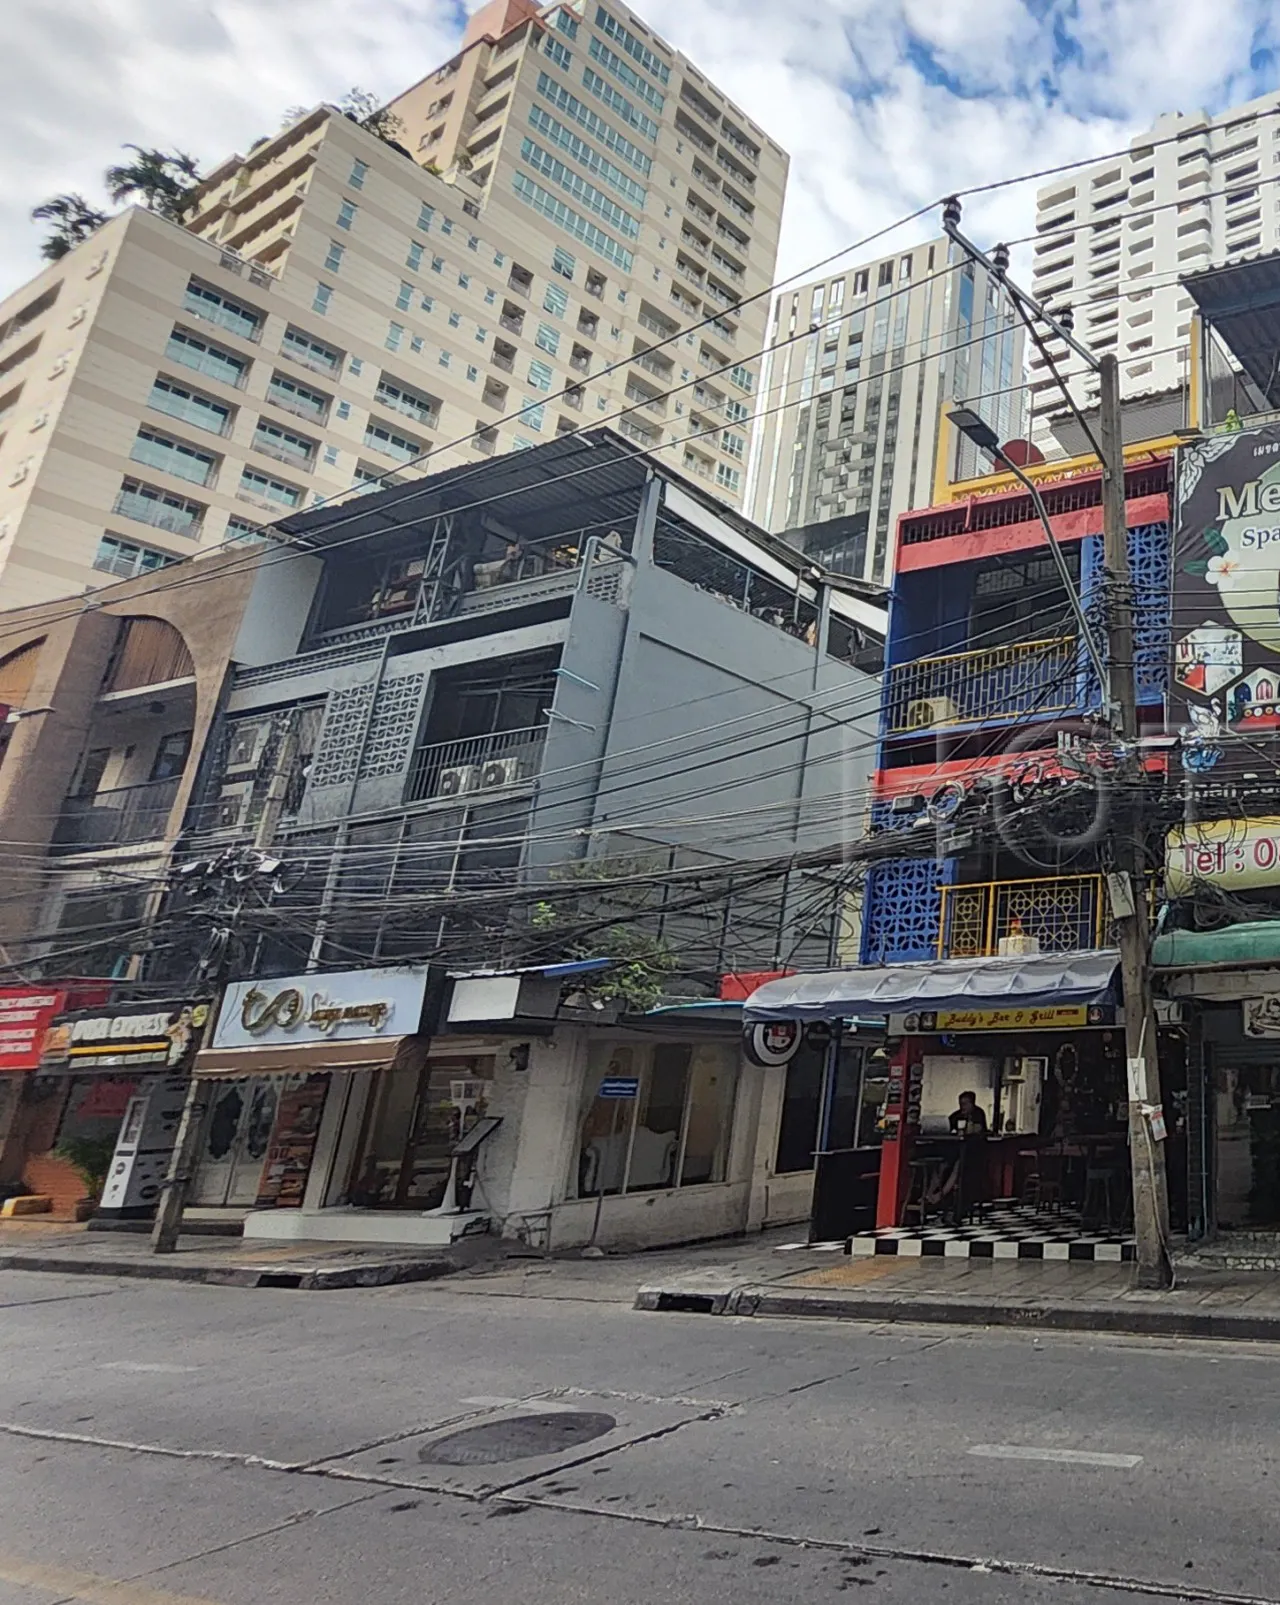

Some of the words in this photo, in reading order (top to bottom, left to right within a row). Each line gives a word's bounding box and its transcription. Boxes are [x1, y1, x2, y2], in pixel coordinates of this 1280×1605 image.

[1185, 842, 1226, 873] Tel
[1234, 847, 1244, 871] :
[944, 1012, 983, 1026] Buddy's
[988, 1012, 1009, 1026] Bar
[1030, 1009, 1056, 1024] Grill
